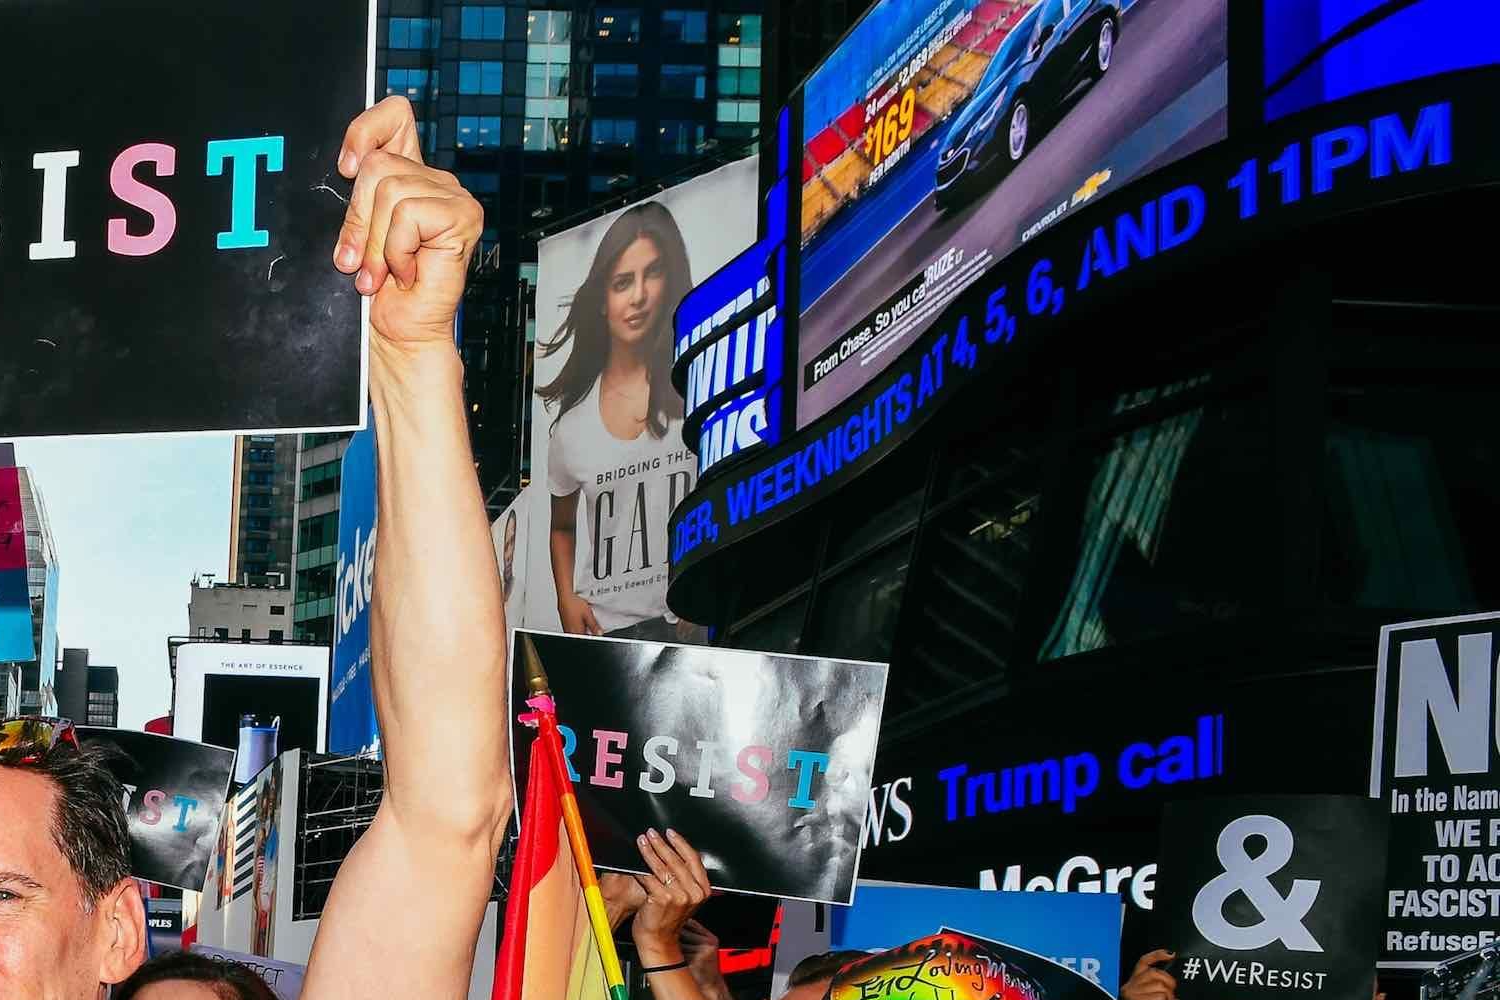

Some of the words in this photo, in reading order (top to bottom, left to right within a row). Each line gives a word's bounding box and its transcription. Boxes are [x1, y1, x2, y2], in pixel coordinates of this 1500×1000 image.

[864, 88, 917, 166] $169
[726, 383, 912, 527] WEEKNIGHTS
[916, 332, 949, 409] AT
[984, 285, 1017, 344] 5,
[1026, 257, 1065, 317] 6,
[1076, 183, 1206, 292] AND
[1228, 101, 1453, 220] 11PM
[813, 352, 840, 382] From
[839, 326, 874, 361] Chase.
[874, 310, 891, 333] So
[891, 291, 912, 326] you
[596, 457, 661, 485] BRIDGING
[667, 449, 693, 466] THE
[238, 662, 253, 670] ART
[269, 663, 304, 671] ESSENCE
[1394, 632, 1500, 778] N
[937, 752, 1100, 822] Trump
[1391, 788, 1410, 814] In
[1414, 787, 1448, 807] the
[1434, 818, 1482, 848] WE
[1192, 814, 1325, 953] &
[1422, 853, 1461, 883] TO
[1386, 931, 1500, 951] RefuseF
